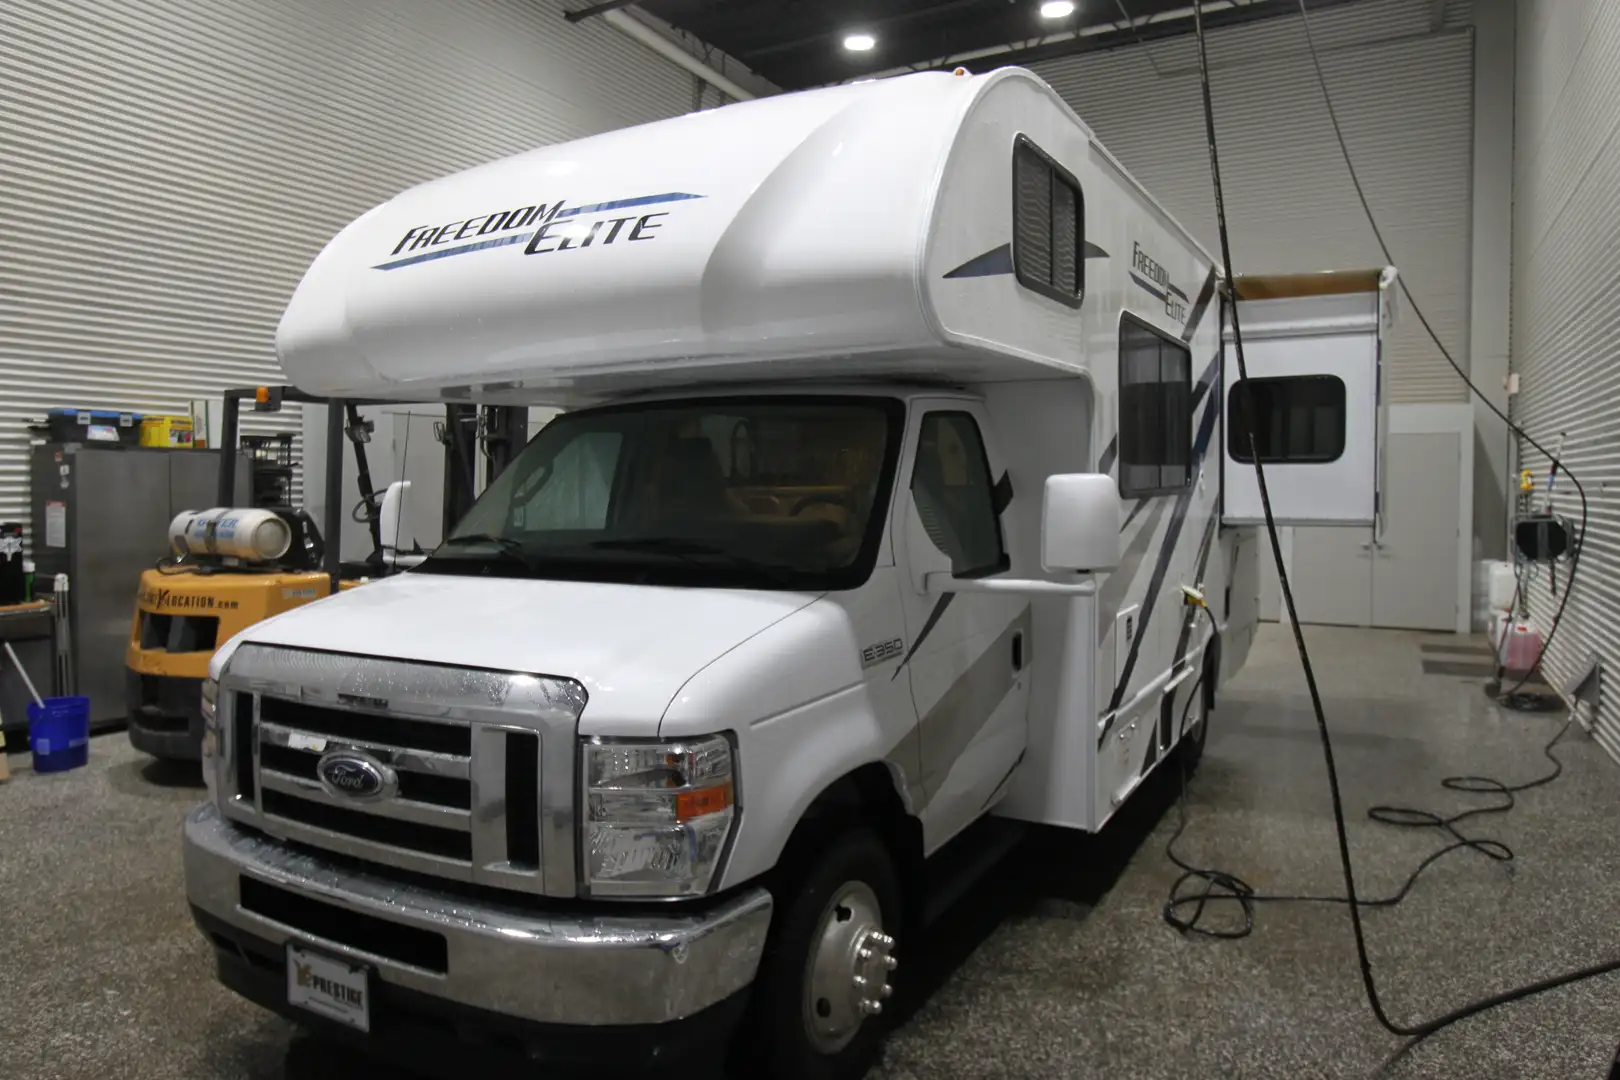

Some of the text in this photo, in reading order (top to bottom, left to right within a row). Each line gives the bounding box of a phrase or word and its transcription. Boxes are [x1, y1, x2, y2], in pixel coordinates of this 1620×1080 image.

[391, 200, 567, 256] FREEDOM
[523, 212, 670, 256] ELITE
[1132, 240, 1170, 287] FREEDOM
[1165, 291, 1186, 326] ELITE
[331, 764, 365, 789] Ford
[312, 974, 363, 1006] PRESTIGE
